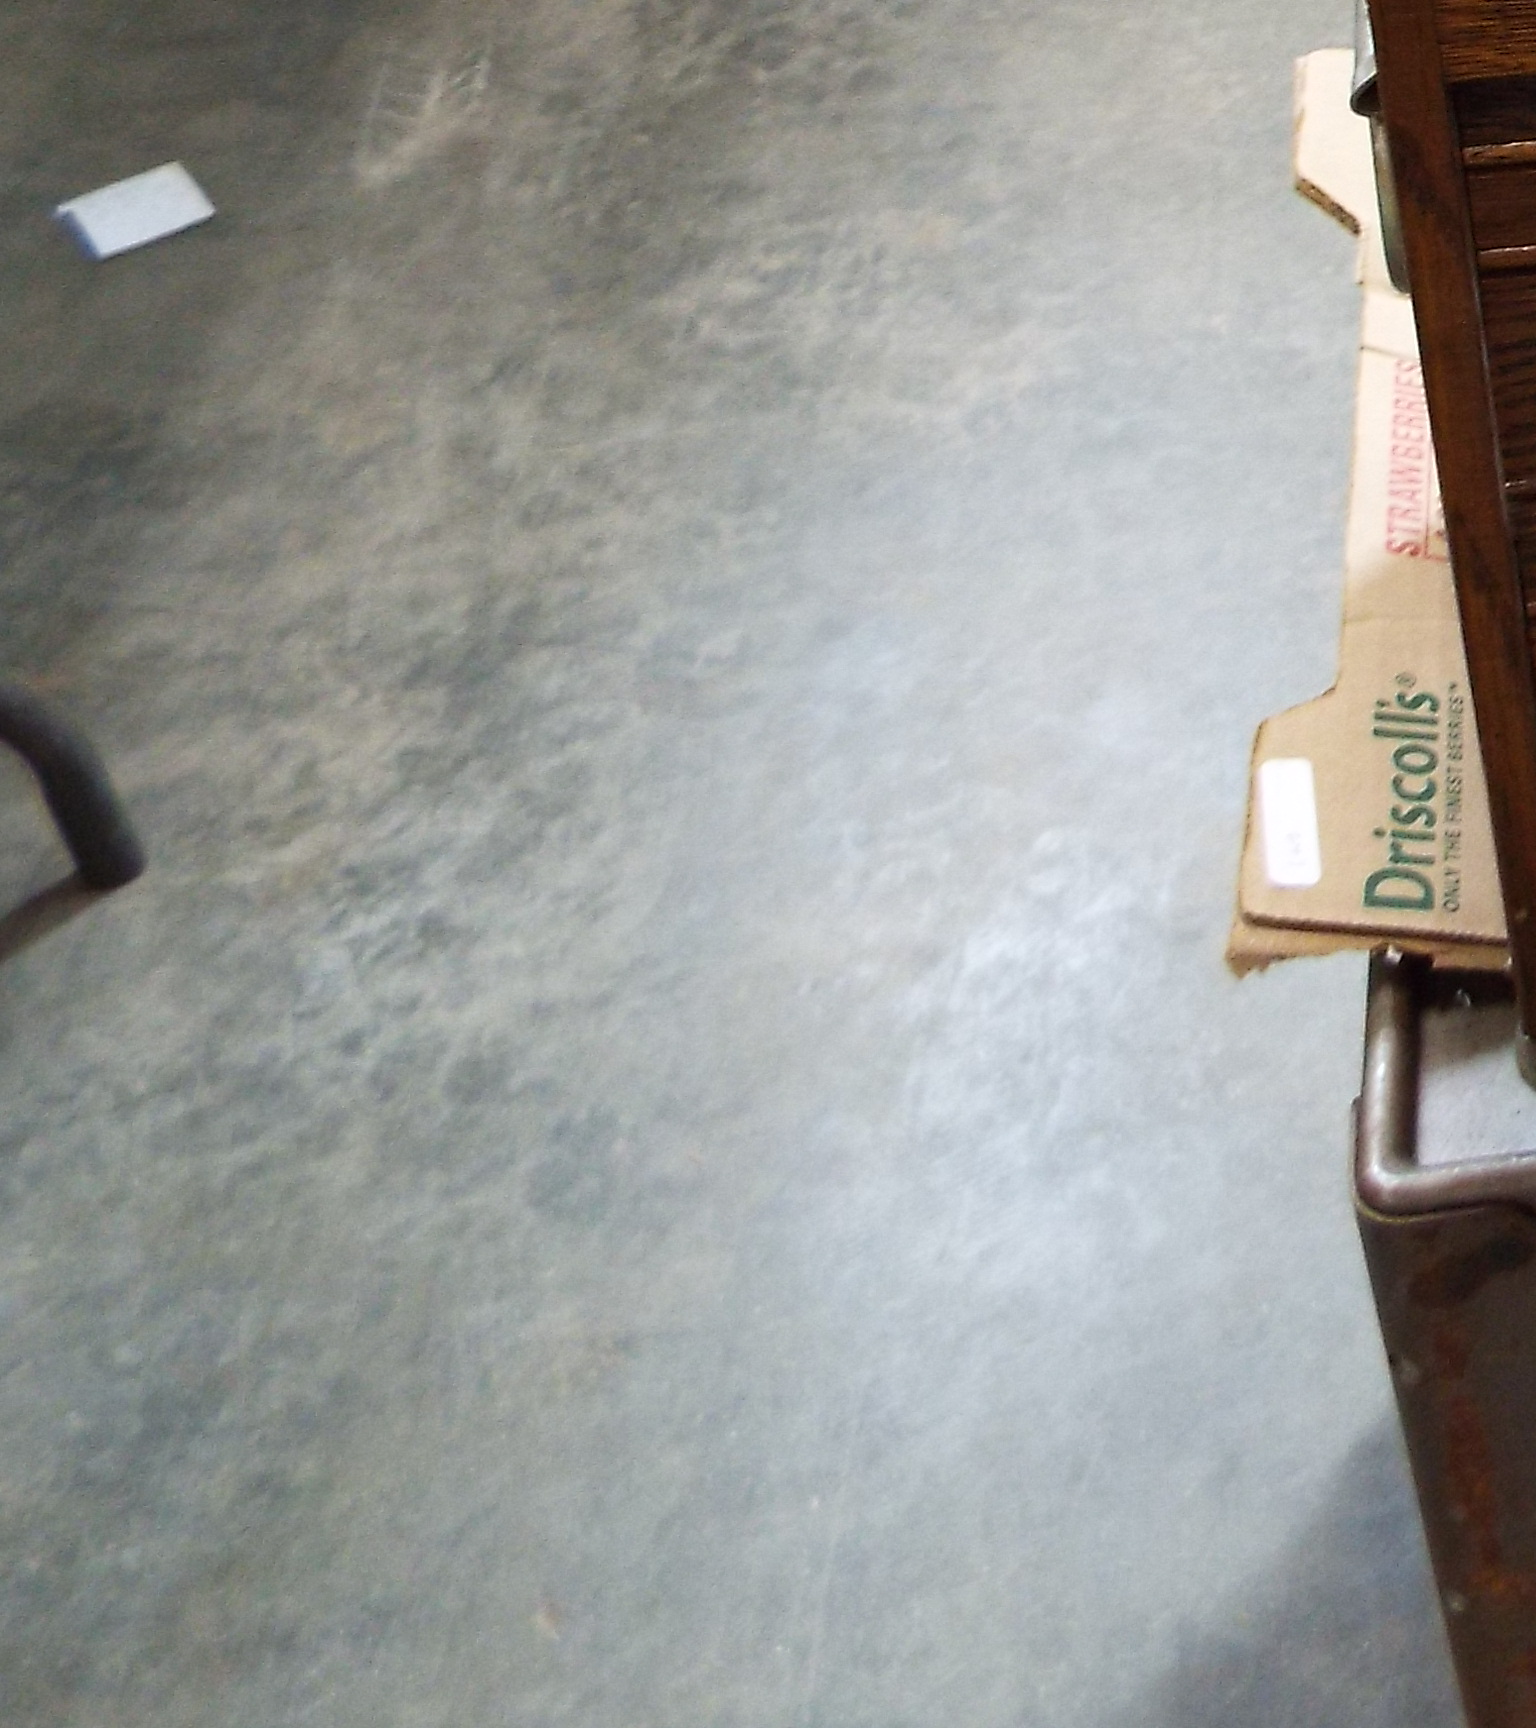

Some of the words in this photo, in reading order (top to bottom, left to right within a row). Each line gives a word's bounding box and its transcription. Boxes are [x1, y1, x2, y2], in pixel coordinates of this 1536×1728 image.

[1386, 358, 1426, 558] STRAWBERRIES
[1444, 768, 1463, 825] FINEST
[1443, 829, 1462, 862] THE
[1443, 870, 1461, 913] ONLY
